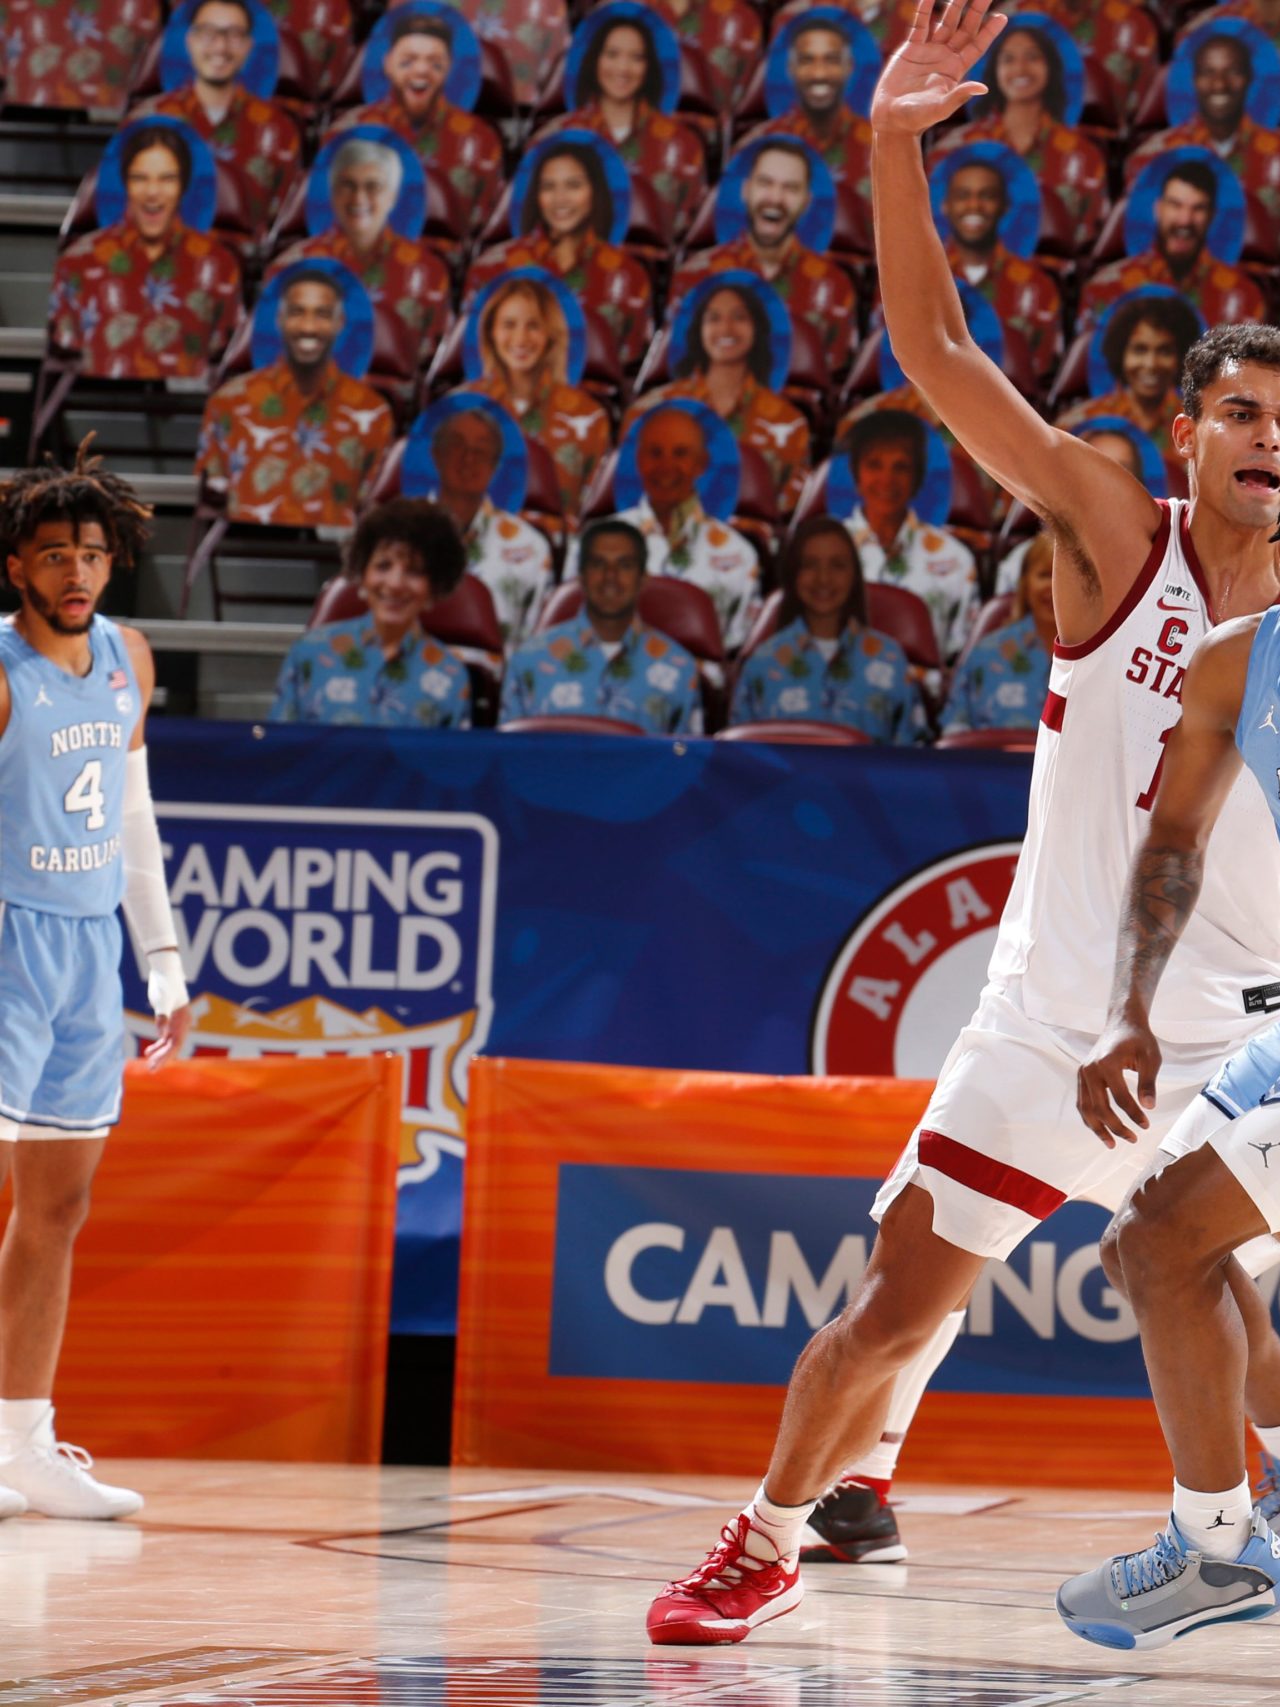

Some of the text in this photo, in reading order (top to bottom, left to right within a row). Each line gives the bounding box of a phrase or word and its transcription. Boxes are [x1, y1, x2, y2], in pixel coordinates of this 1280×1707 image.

[52, 721, 122, 758] NORTH
[63, 759, 106, 832] 4
[162, 842, 464, 916] AMPING
[847, 864, 1017, 1021] ALA
[604, 1222, 1140, 1344] CAMNG
